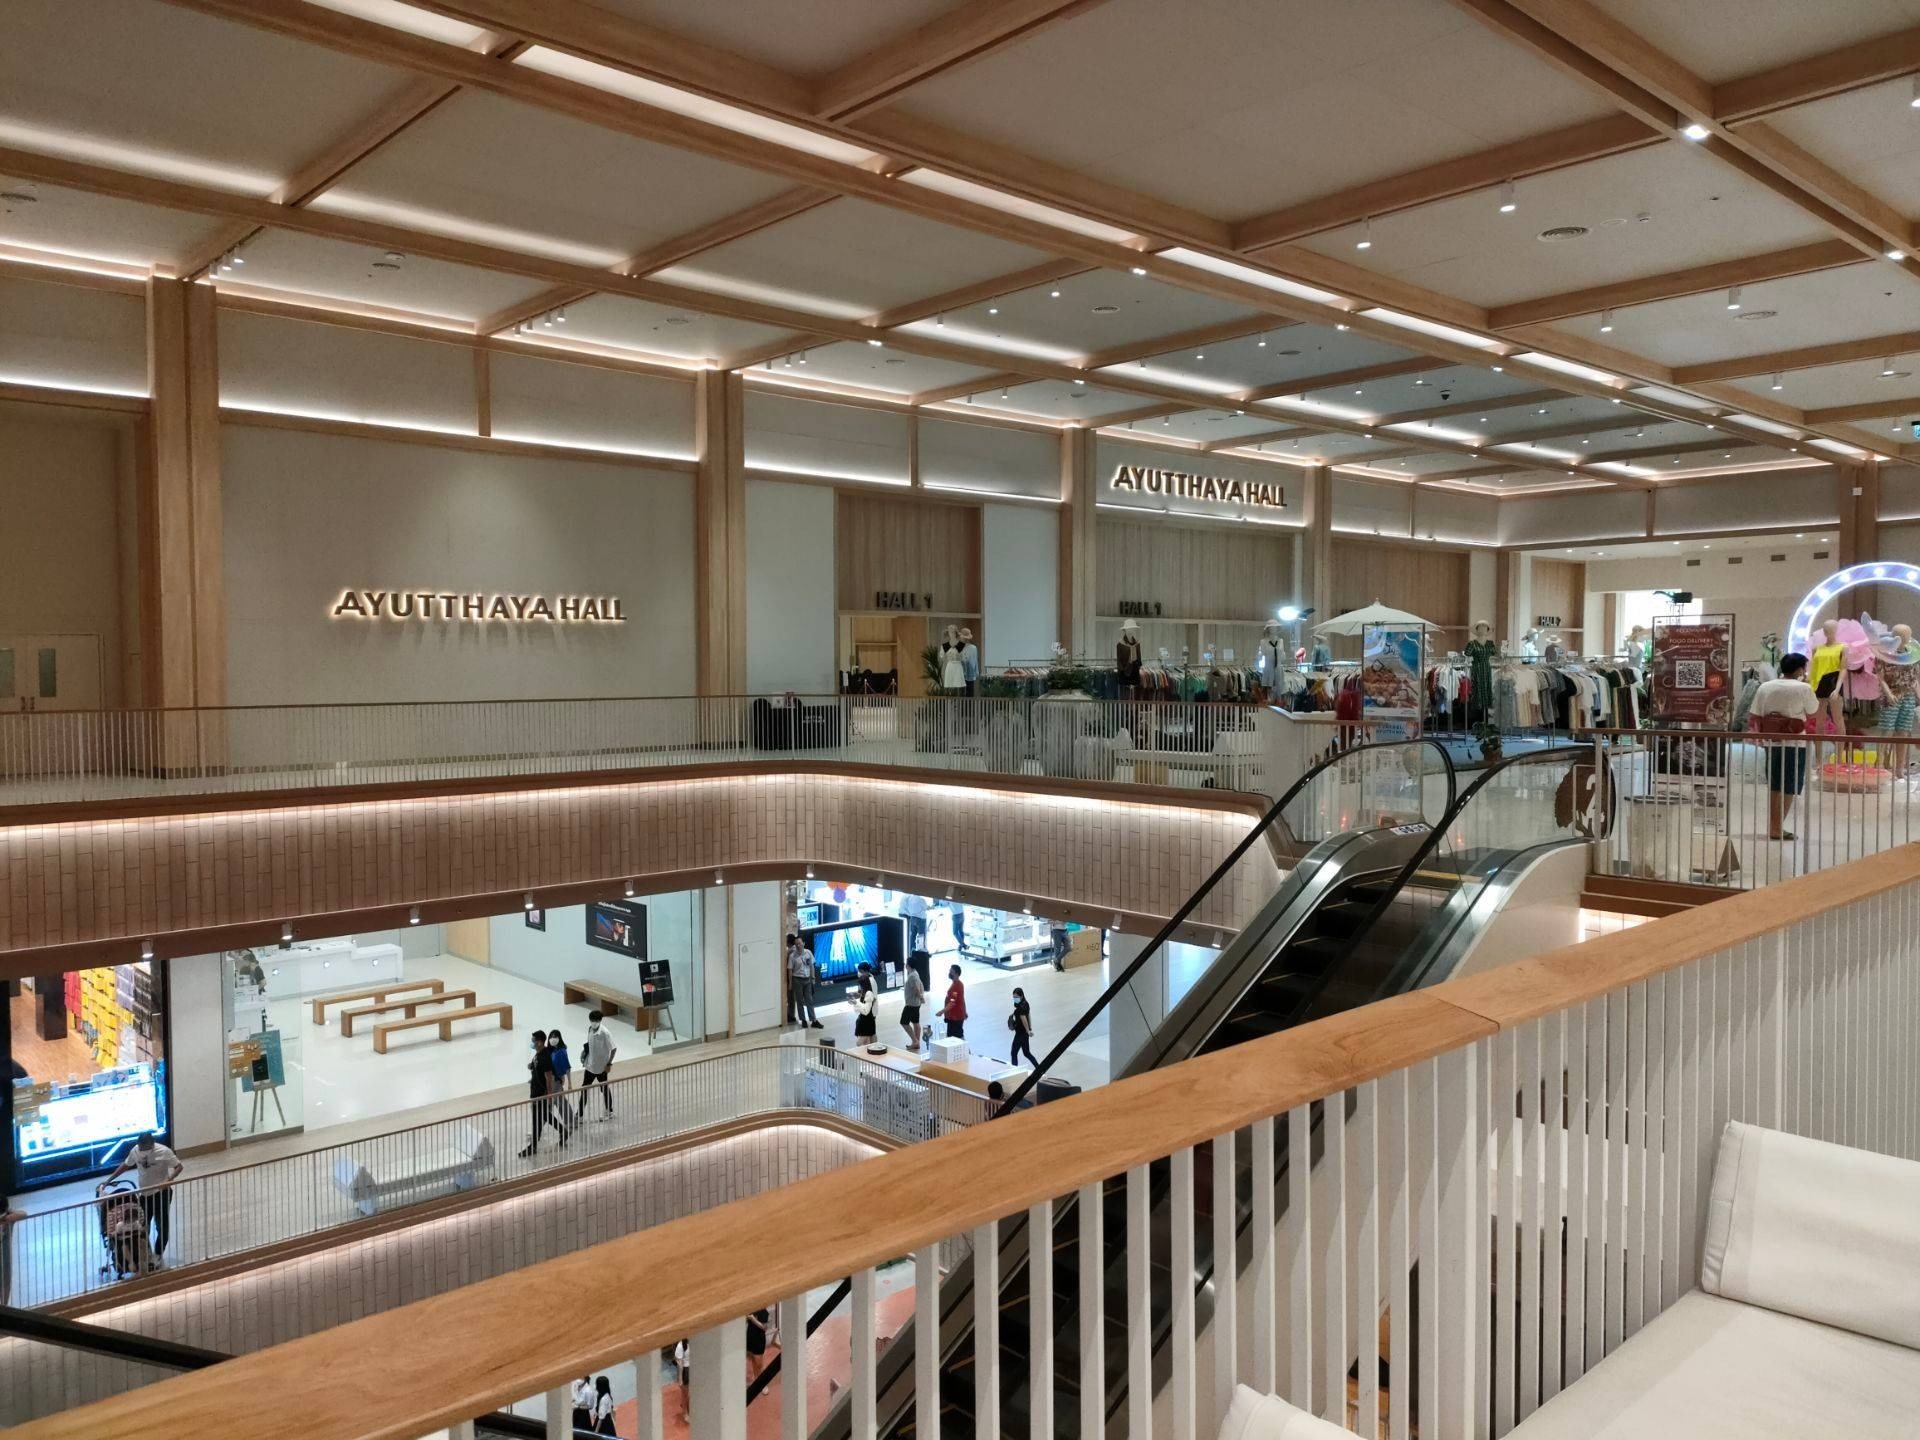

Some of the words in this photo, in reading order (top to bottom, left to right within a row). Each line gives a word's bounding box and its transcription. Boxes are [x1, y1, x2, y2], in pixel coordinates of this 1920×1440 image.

[1112, 465, 1244, 503] AYUTTHAYA
[1245, 482, 1288, 508] HALL
[333, 590, 555, 620] AYUTTHAYA
[559, 597, 628, 622] HALL
[876, 591, 920, 609] HALL
[923, 592, 932, 609] 1
[1119, 601, 1153, 616] HALL
